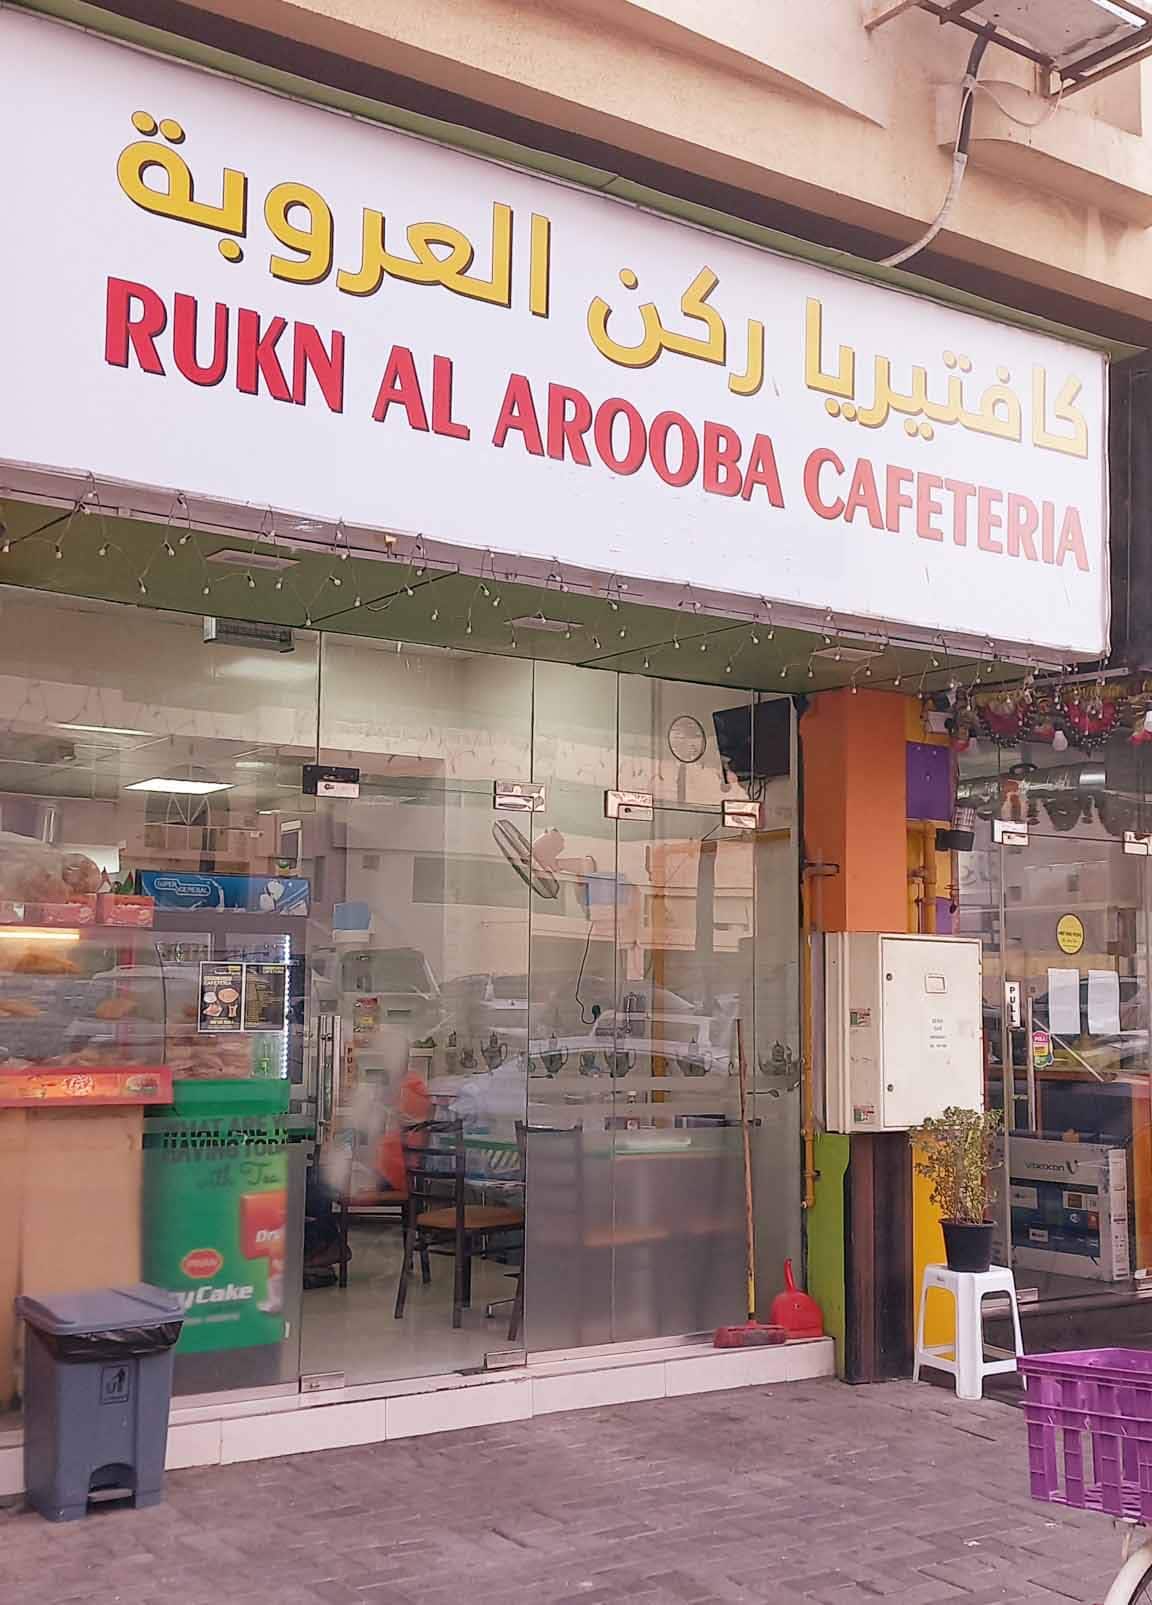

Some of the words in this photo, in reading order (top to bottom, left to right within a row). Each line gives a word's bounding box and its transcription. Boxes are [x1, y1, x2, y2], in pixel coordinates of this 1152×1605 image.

[115, 110, 552, 320] العروبة
[587, 264, 765, 395] ركن
[104, 276, 346, 415] RUKN
[372, 345, 470, 441] AL
[493, 373, 785, 509] AROOBA
[802, 447, 1090, 572] CAFETERIA
[1008, 986, 1018, 1023] PULL
